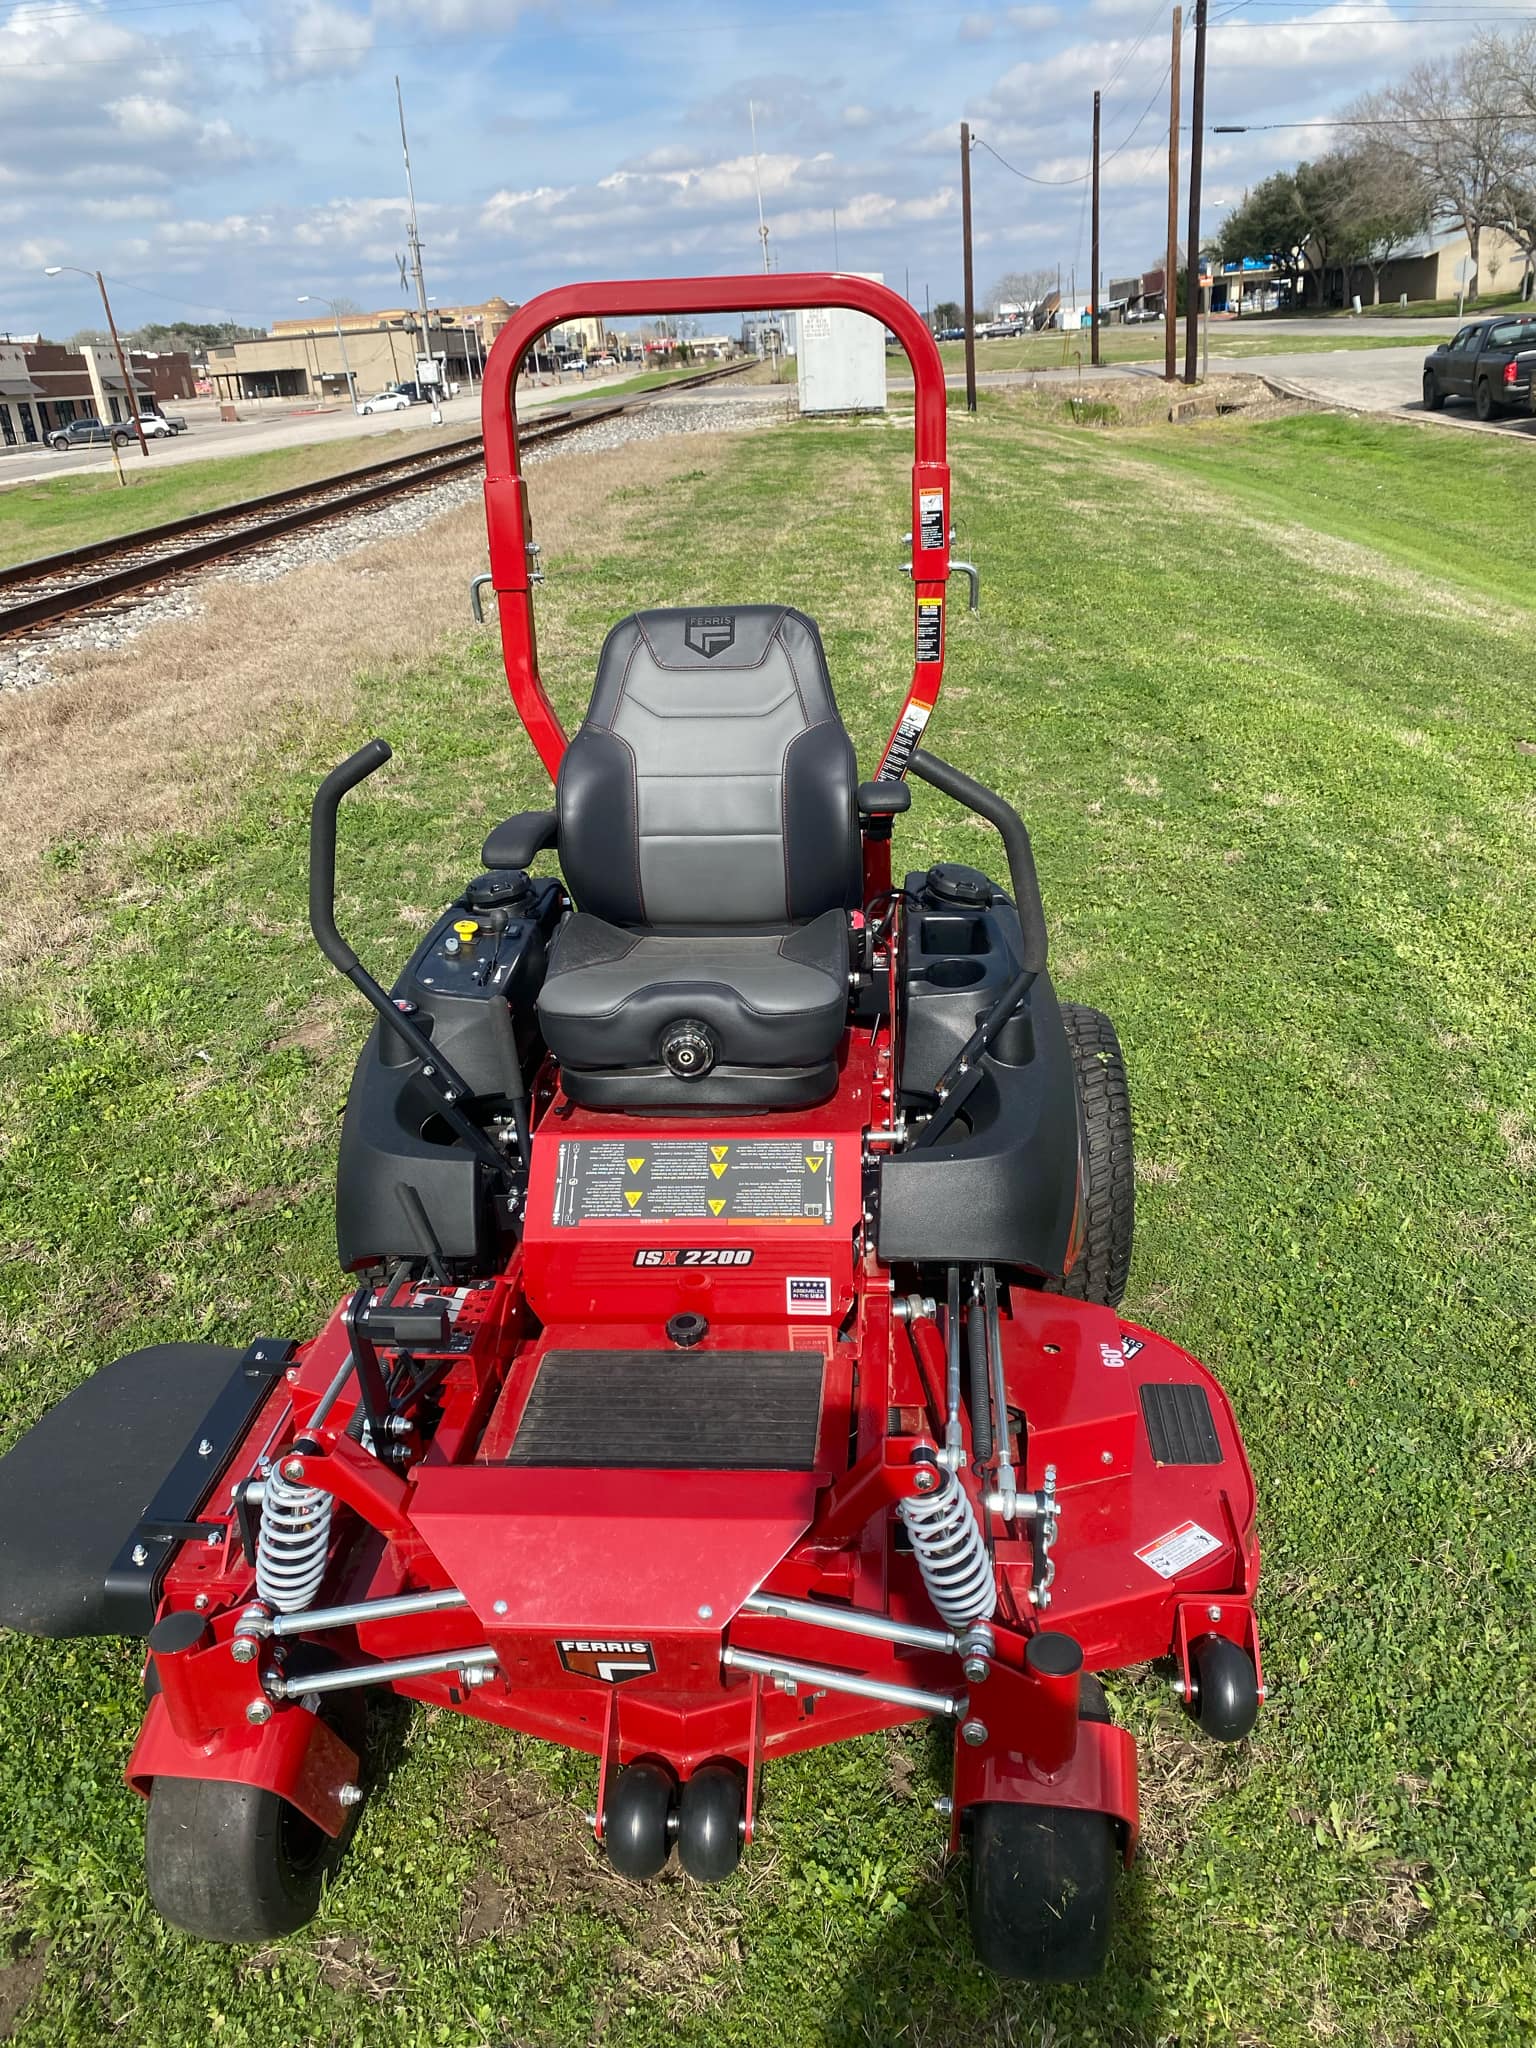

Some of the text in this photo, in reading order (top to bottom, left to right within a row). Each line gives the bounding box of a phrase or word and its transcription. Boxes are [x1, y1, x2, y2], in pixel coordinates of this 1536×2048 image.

[690, 616, 731, 625] FERRIS
[635, 1250, 752, 1266] ISX 2200
[561, 1641, 647, 1653] FERRIS
